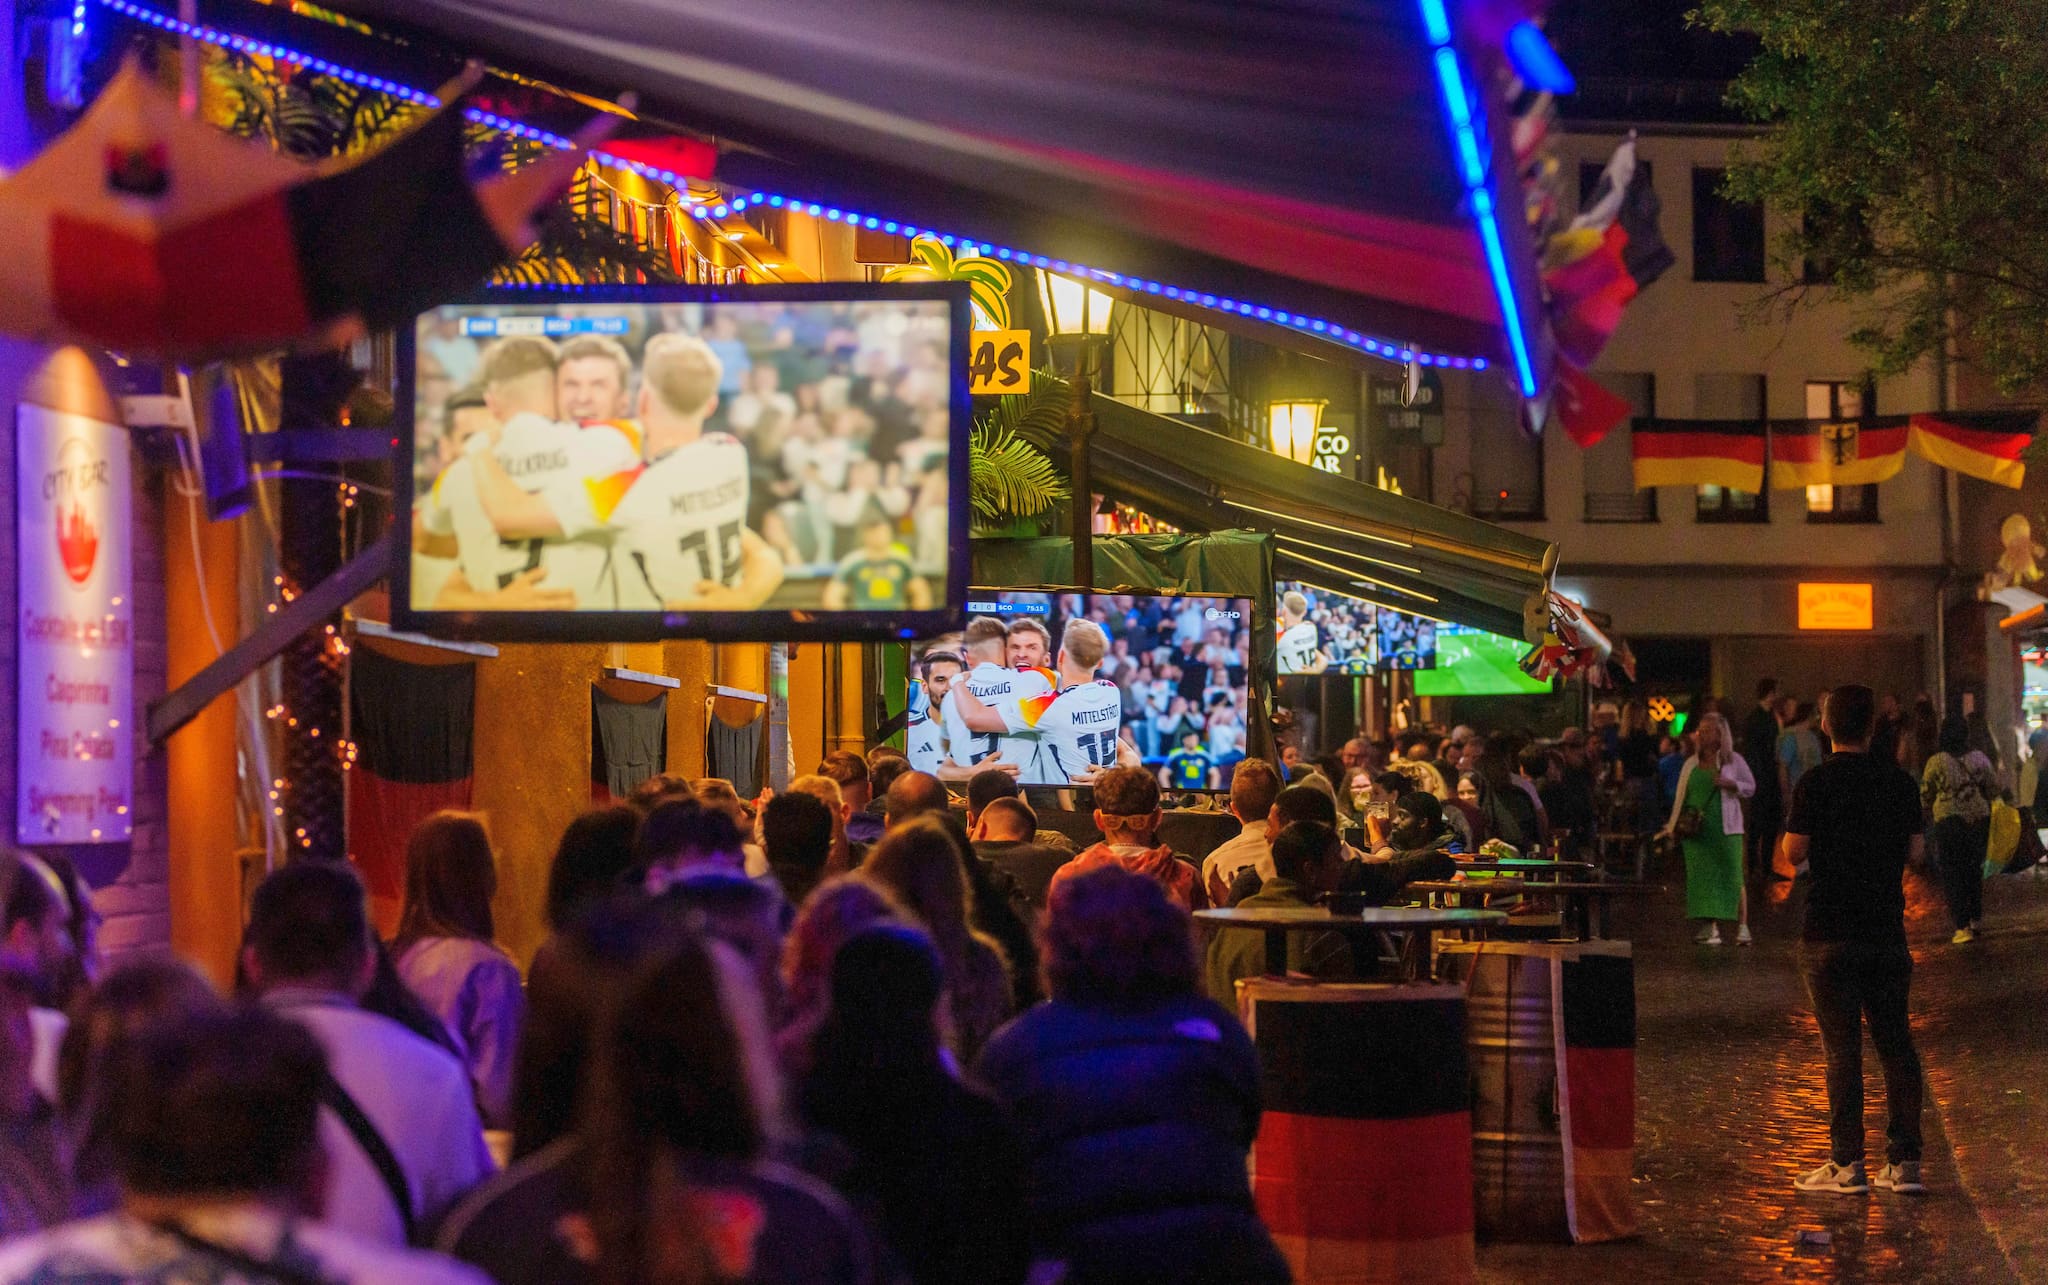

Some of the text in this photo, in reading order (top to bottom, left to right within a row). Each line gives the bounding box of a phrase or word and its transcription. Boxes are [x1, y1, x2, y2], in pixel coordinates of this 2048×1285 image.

[969, 341, 1023, 388] AS
[1316, 435, 1350, 455] CO
[1312, 455, 1342, 473] AR
